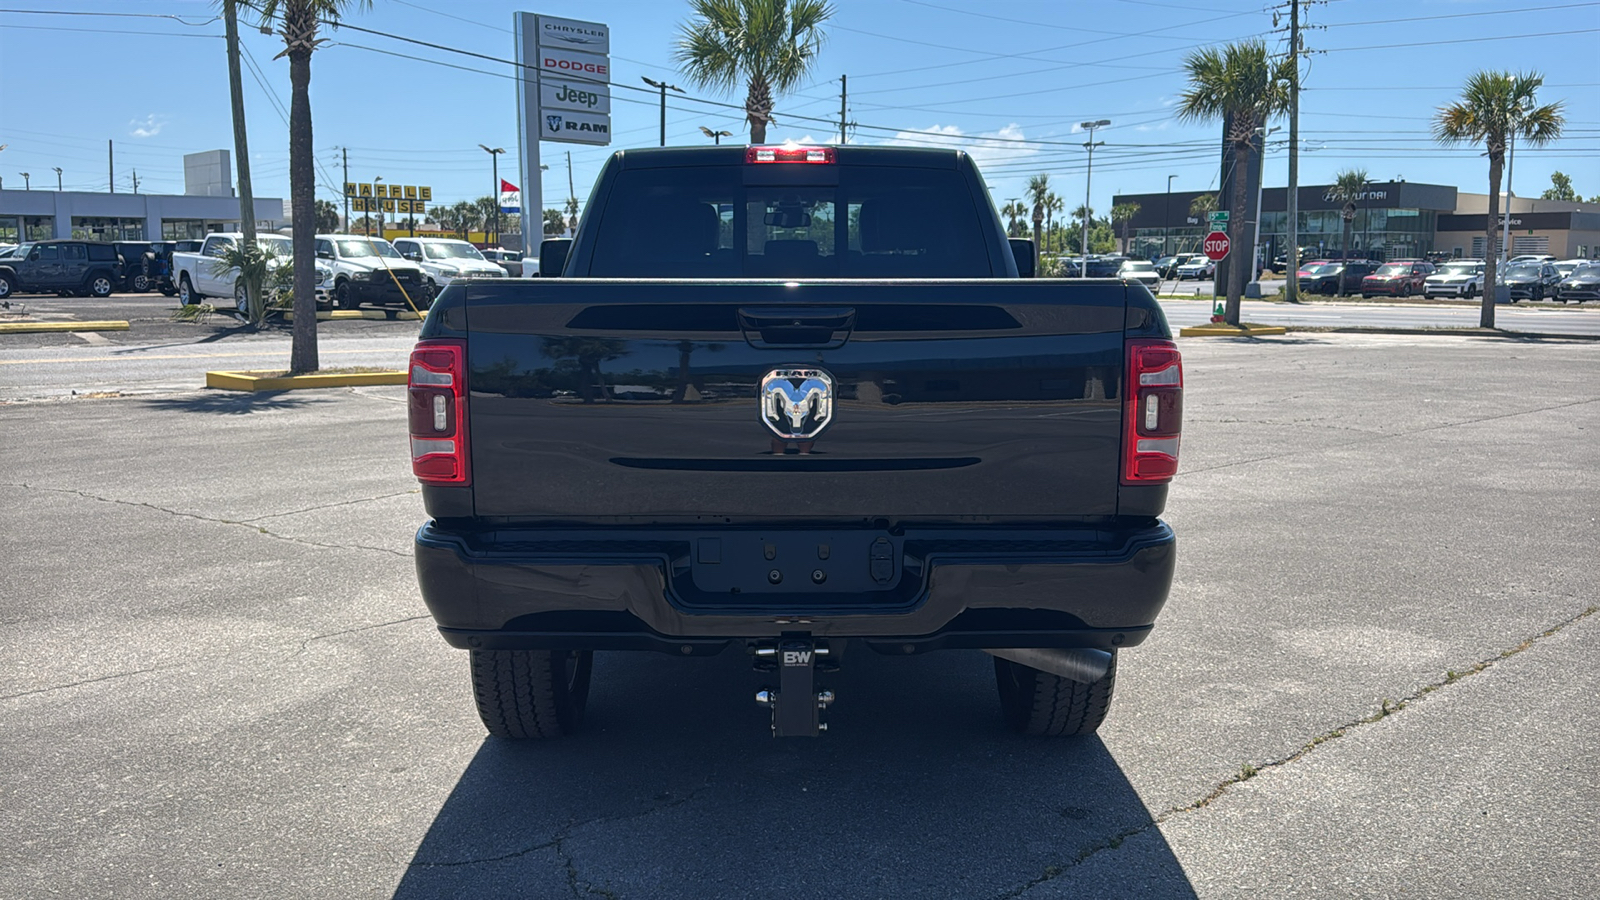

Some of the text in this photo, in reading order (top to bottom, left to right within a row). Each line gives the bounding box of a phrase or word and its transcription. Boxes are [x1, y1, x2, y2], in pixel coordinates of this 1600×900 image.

[545, 24, 604, 37] CHRYSLER
[544, 58, 606, 74] DODGE
[556, 85, 598, 108] Jeep
[566, 121, 608, 133] RAM
[346, 185, 430, 197] WAFFLE
[1206, 240, 1228, 252] STOP
